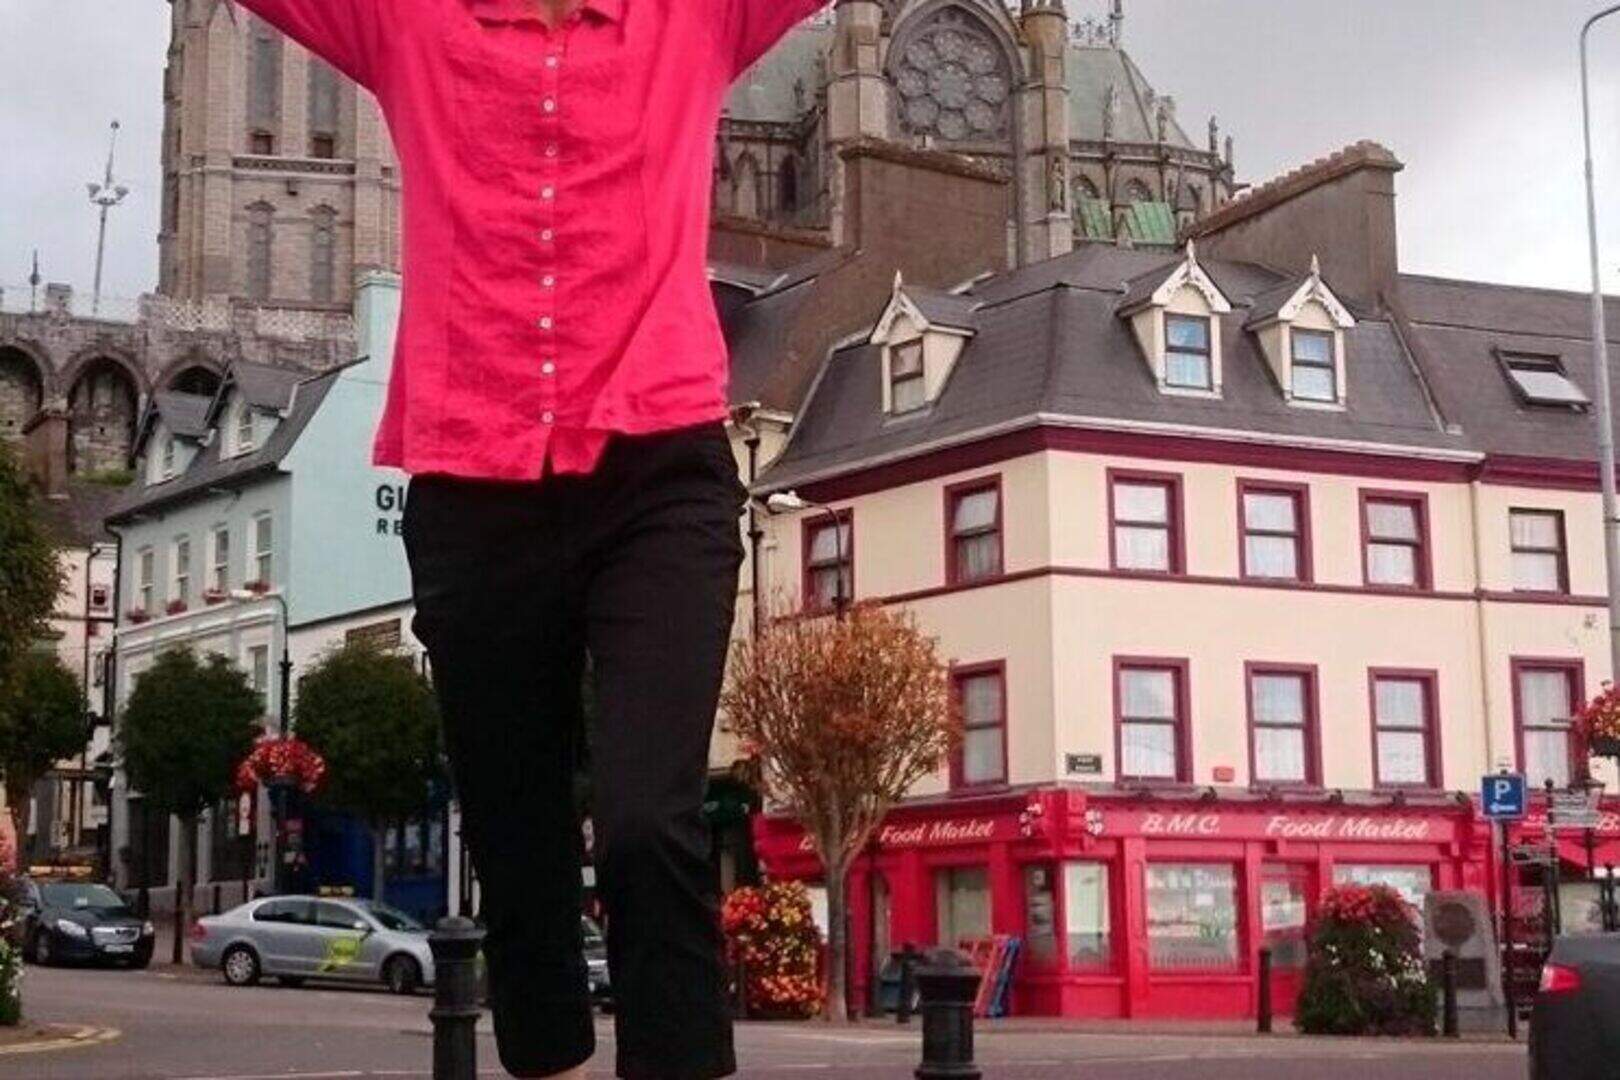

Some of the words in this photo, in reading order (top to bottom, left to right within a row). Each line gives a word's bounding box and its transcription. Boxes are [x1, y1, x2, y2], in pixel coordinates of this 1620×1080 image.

[1494, 780, 1511, 800] P
[879, 822, 927, 845] Food
[929, 818, 995, 841] Market
[1140, 813, 1221, 835] B.M.C.
[1265, 815, 1335, 838] Food
[1338, 816, 1430, 840] Market
